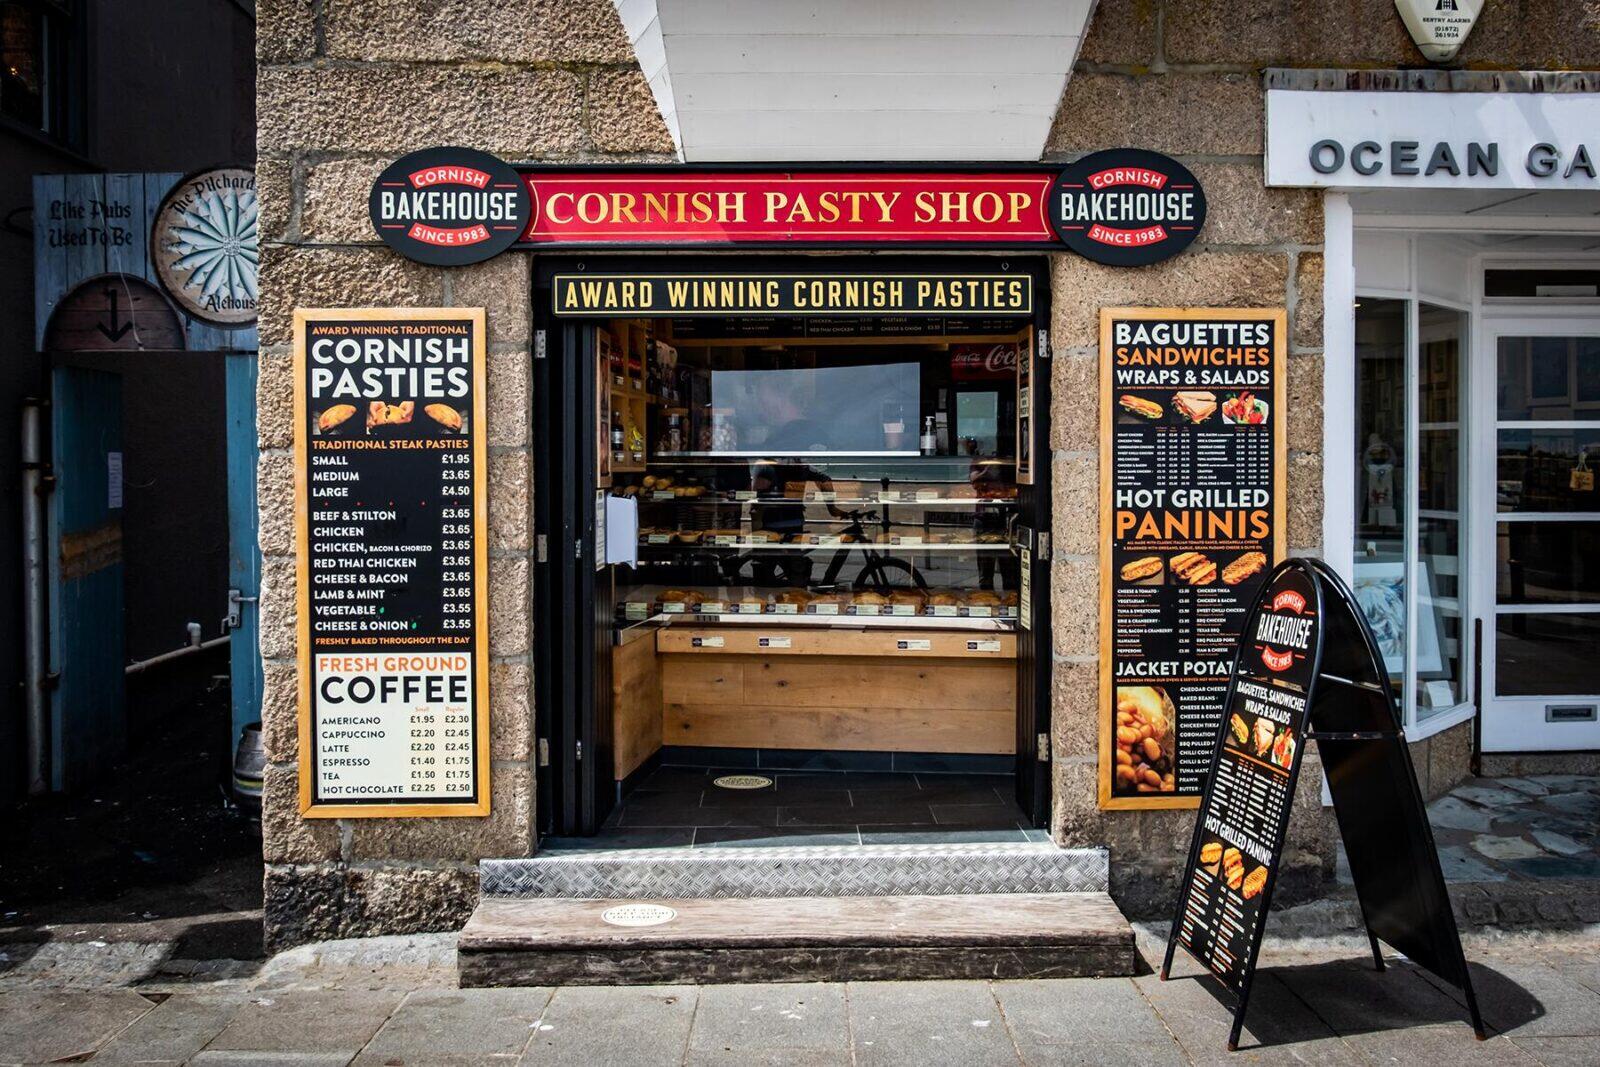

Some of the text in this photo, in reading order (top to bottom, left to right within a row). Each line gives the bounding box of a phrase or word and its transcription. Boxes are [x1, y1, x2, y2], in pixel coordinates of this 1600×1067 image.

[1309, 139, 1498, 177] OCEAN
[415, 168, 485, 187] CORNISH
[1093, 170, 1162, 188] CORNISH
[168, 174, 255, 215] The Pilchard
[50, 200, 131, 220] Like Pubs
[382, 191, 517, 220] BAKEHOUSE
[545, 191, 1032, 224] CORNISH PASTY SHOP
[1061, 192, 1194, 221] BAKEHOUSE
[49, 227, 132, 248] Used To Be
[414, 224, 486, 243] SINCE 1983
[1092, 227, 1163, 244] SINCE 1983
[204, 295, 256, 312] Alehous
[565, 281, 1022, 308] AWARD WINNING CORNISH PASTIES
[312, 326, 468, 335] AWARD WINNING TRADITIONAL
[1116, 324, 1270, 345] BAGUETTES
[312, 338, 468, 364] CORNISH
[1117, 347, 1270, 366] SANDWICHES
[312, 367, 468, 398] PASTIES
[1117, 370, 1270, 385] WRAPS & SALADS
[313, 440, 468, 449] TRADITIONAL STEAK PASTIES
[313, 454, 470, 466] SMALL £1.95
[313, 470, 470, 481] MEDIUM £3.65
[313, 486, 470, 497] LARGE £4.50
[1117, 489, 1269, 508] HOT GRILLED
[313, 509, 470, 521] BEEF & STILTON £3.65
[314, 525, 470, 537] CHICKEN £3.65
[1117, 510, 1269, 540] PANINIS
[314, 543, 368, 554] CHICKEN,
[442, 541, 470, 550] £3.65
[314, 556, 470, 568] RED THAI CHICKEN £3.65
[314, 572, 470, 584] CHEESE & BACON £3.65
[314, 588, 470, 599] LAMB & MINT £3.65
[1274, 593, 1303, 609] CORNISH
[315, 604, 471, 615] VEGETABLE £3.55
[315, 620, 471, 631] CHEESE & ONION £3.55
[1256, 613, 1313, 649] BAKEHOUSE
[320, 656, 467, 672] FRESH GROUND
[1264, 650, 1277, 667] SINCE
[1116, 661, 1234, 676] JACKET POTAT
[321, 675, 467, 704] COFFEE
[1237, 681, 1268, 703] BAGUETTES,
[1245, 699, 1291, 725] WRAPS & SALADS
[1205, 814, 1221, 834] HOT
[1220, 823, 1246, 850] GRILLED
